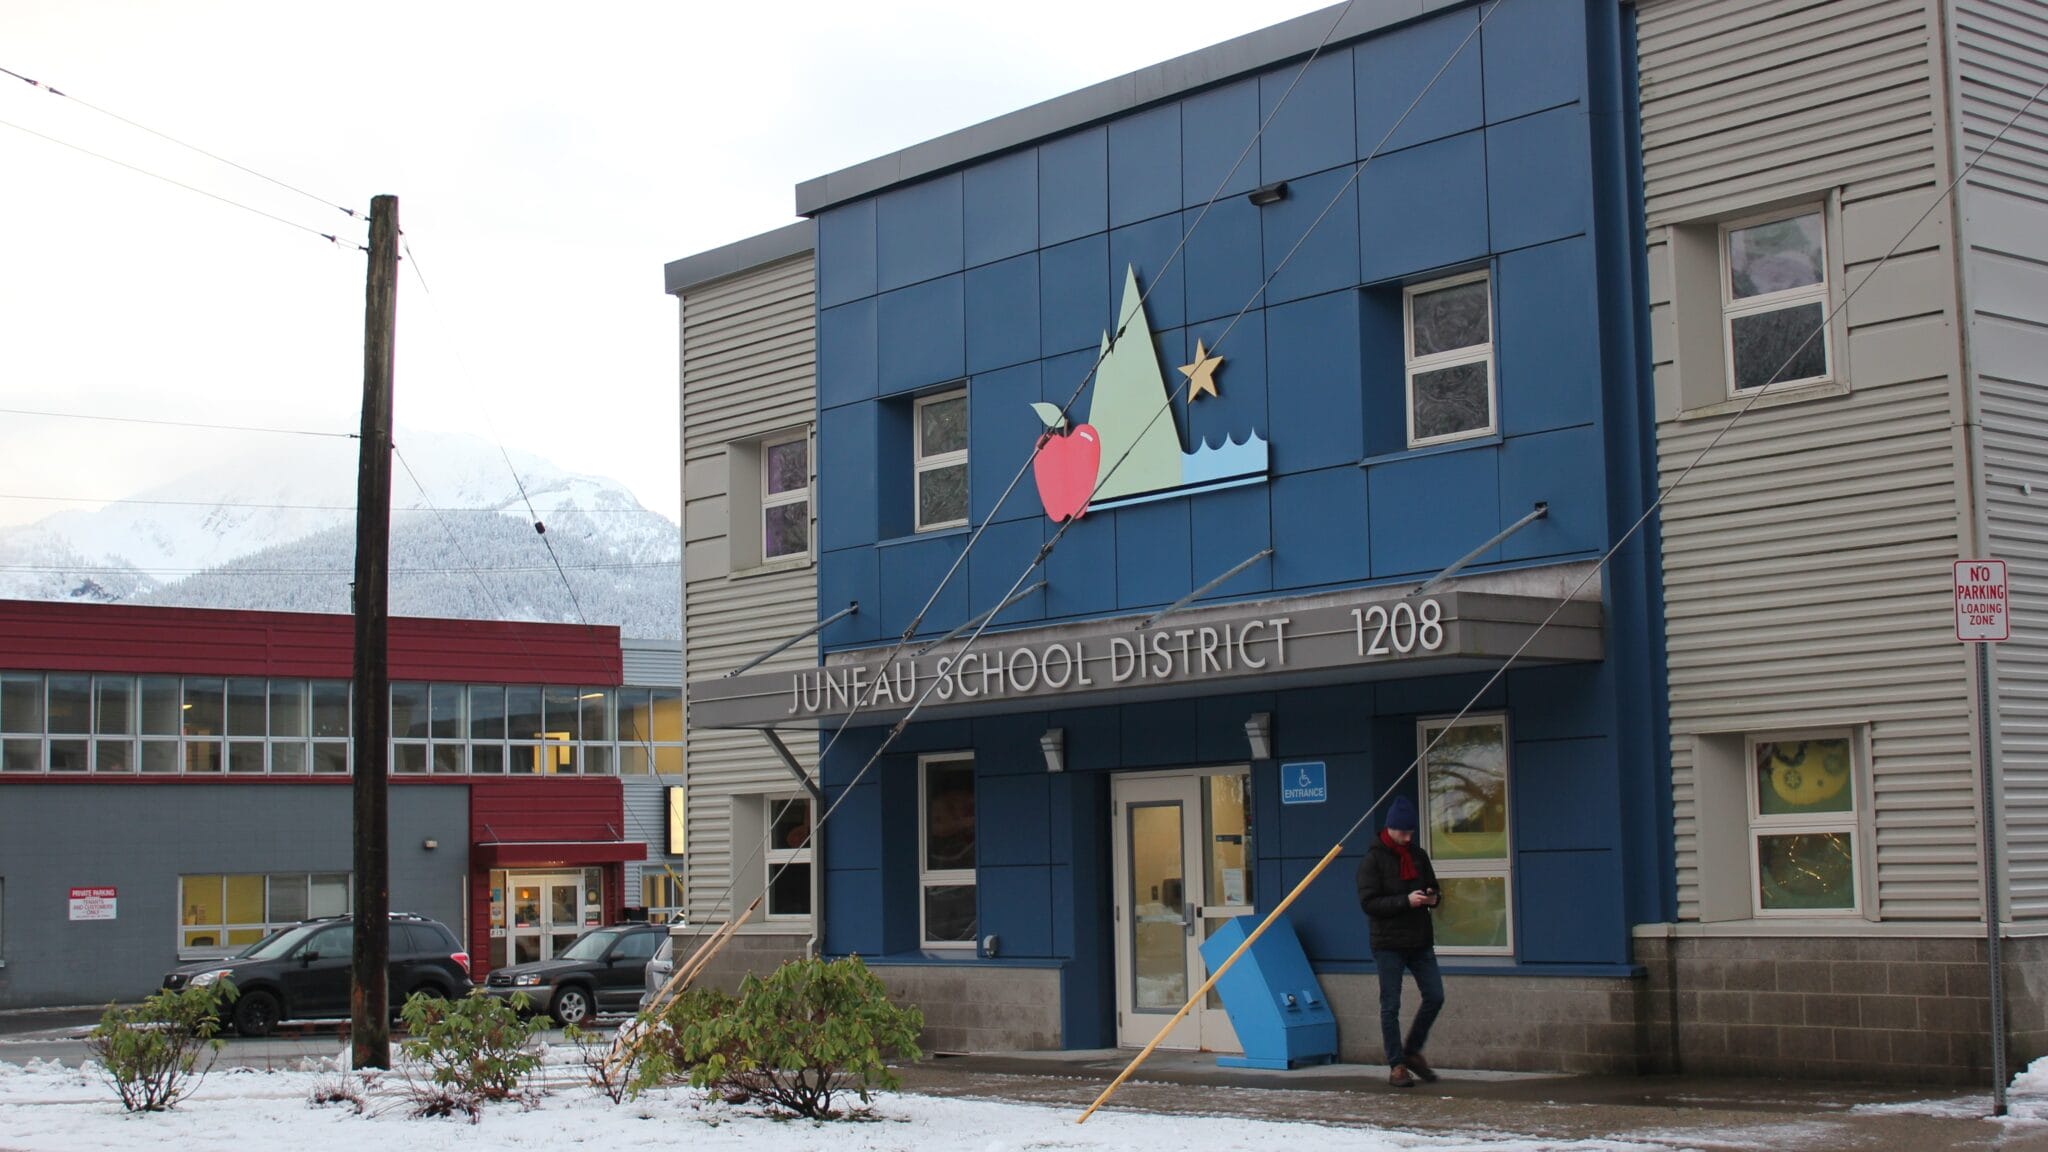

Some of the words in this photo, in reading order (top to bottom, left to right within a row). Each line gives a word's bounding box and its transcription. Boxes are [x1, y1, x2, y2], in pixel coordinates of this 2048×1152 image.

[1970, 567, 1990, 581] NO
[1958, 585, 2004, 600] PARKING
[1961, 603, 2002, 614] LOADING
[1969, 615, 1995, 625] ZONE
[789, 660, 918, 714] JUNEAU
[936, 642, 1092, 700] SCHOOL
[1110, 618, 1291, 683] DISTRICT
[1351, 598, 1444, 657] 1208
[1284, 787, 1324, 799] ENTRANCE
[72, 889, 92, 897] PRIVATE
